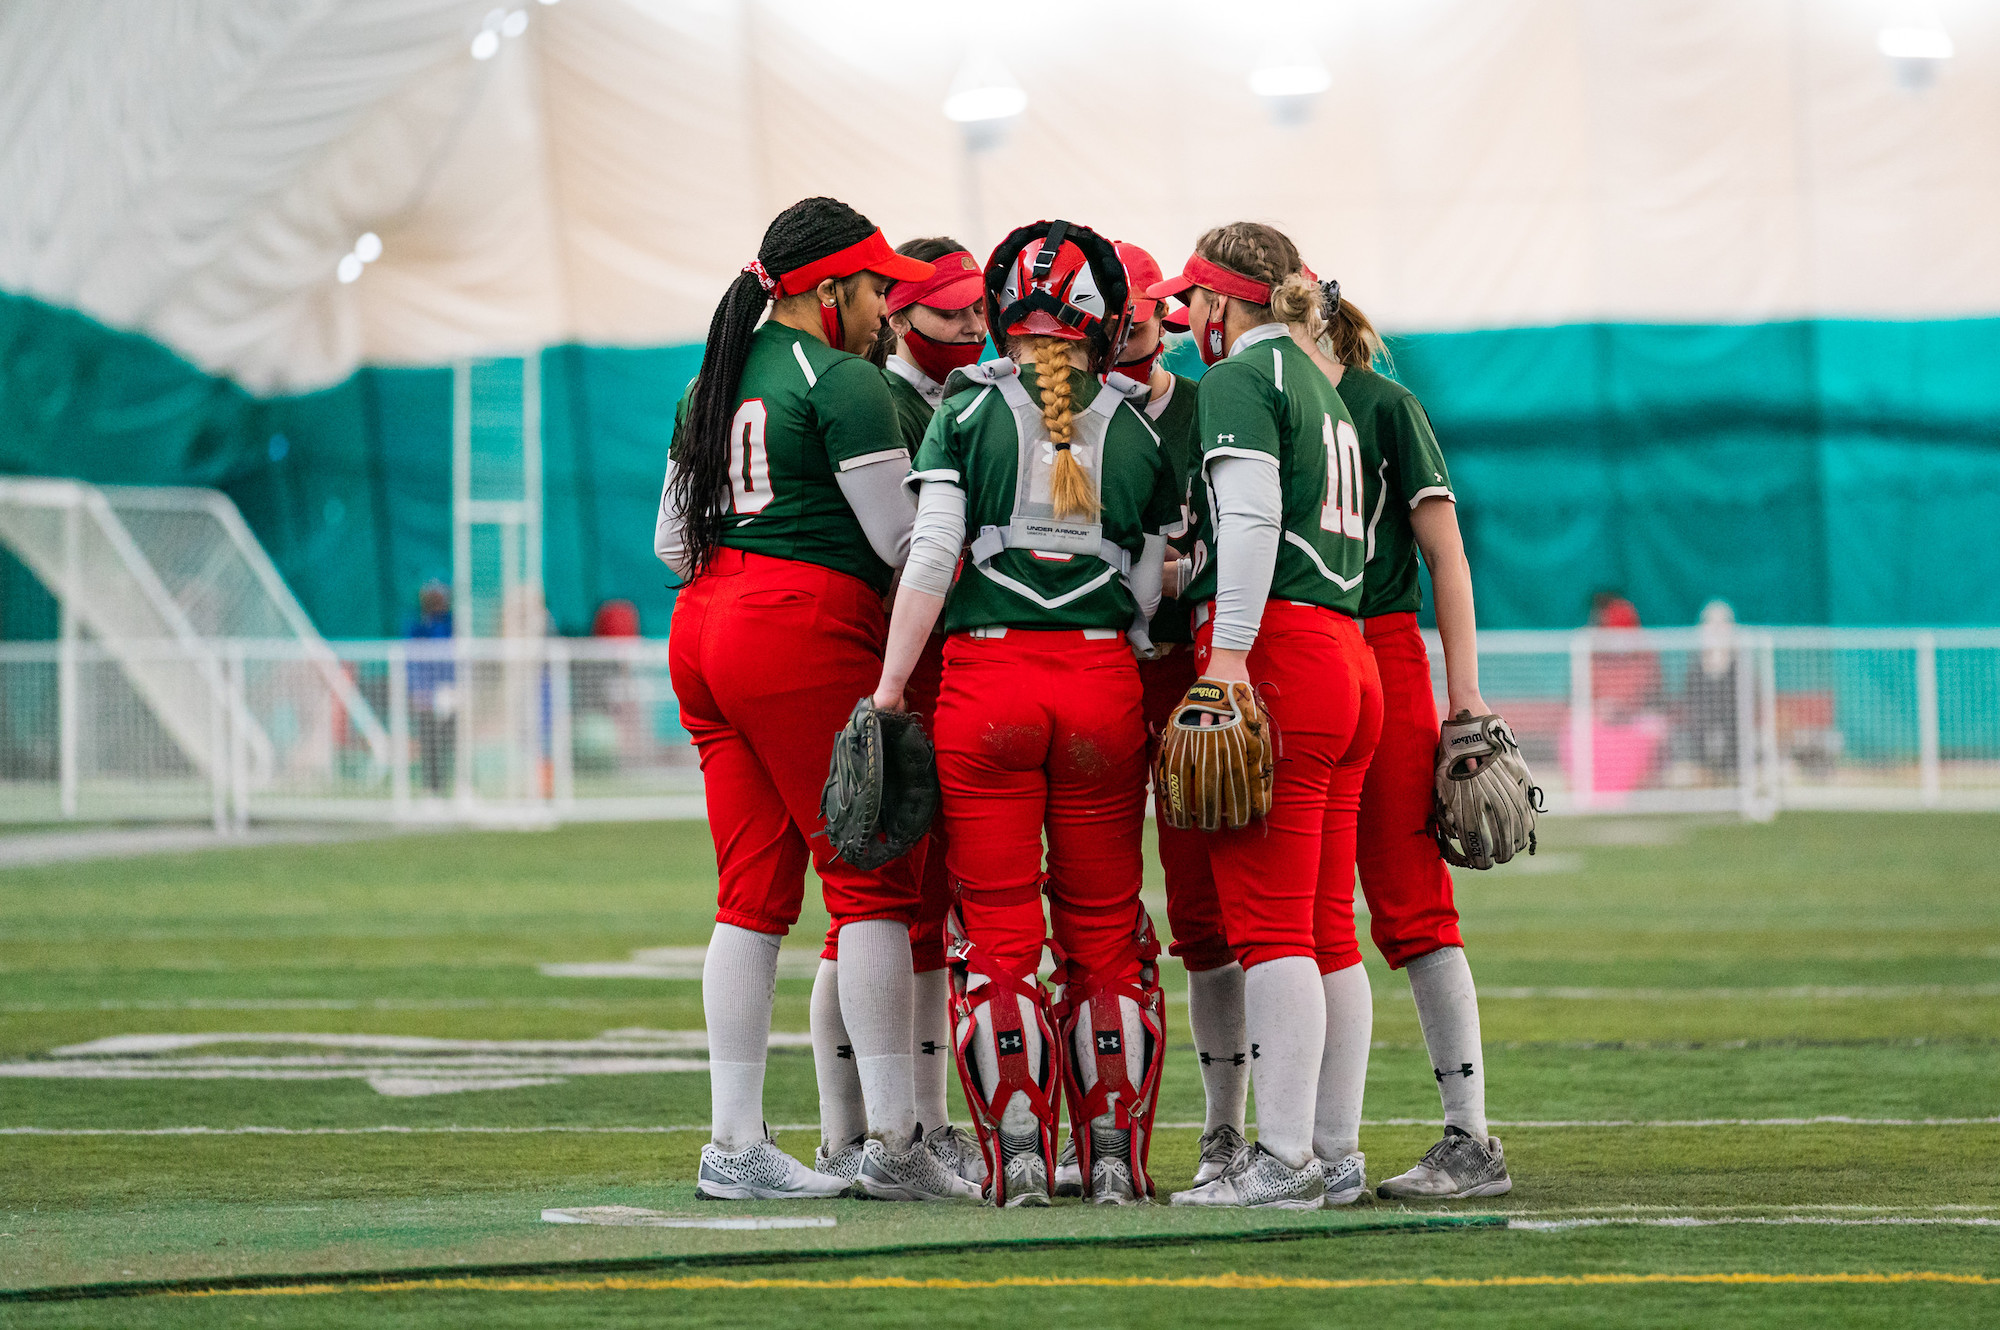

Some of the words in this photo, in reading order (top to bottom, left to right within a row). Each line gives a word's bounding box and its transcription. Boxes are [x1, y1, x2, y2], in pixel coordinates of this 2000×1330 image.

[1320, 412, 1364, 541] 10
[1026, 525, 1053, 533] UNDER
[1055, 528, 1088, 536] ARMOUR
[1190, 687, 1220, 700] Wilson
[1451, 733, 1483, 746] Wilson
[1171, 774, 1182, 812] A2000
[1468, 831, 1482, 857] A2000
